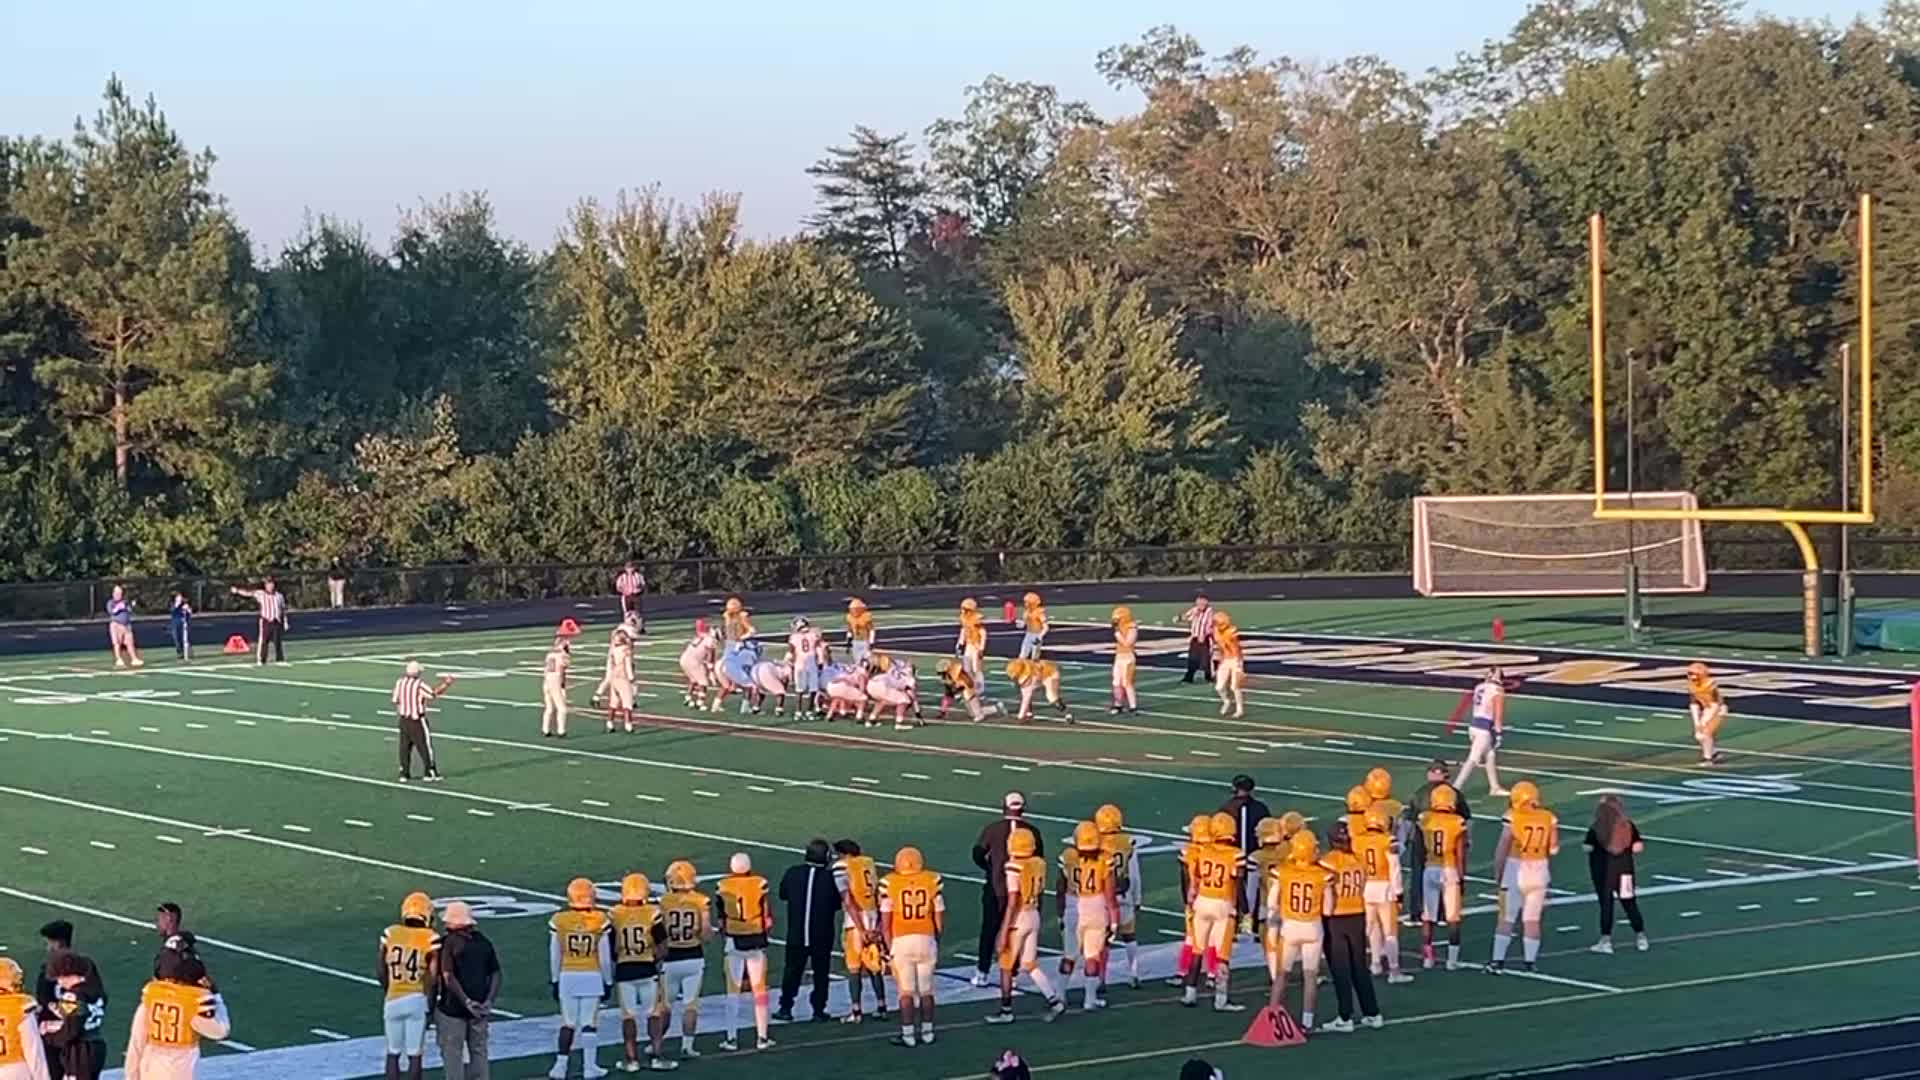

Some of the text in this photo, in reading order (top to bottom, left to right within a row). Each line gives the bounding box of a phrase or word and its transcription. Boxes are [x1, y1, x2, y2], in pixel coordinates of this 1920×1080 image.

[1433, 829, 1444, 857] 8
[1522, 825, 1546, 854] 77
[1366, 848, 1377, 876] 9
[736, 895, 747, 923] 1
[901, 889, 927, 921] 62
[1290, 881, 1312, 914] 66
[622, 926, 646, 956] 15
[669, 910, 695, 943] 22
[390, 945, 419, 982] 24
[151, 1002, 181, 1043] 53
[1267, 1011, 1295, 1041] 30
